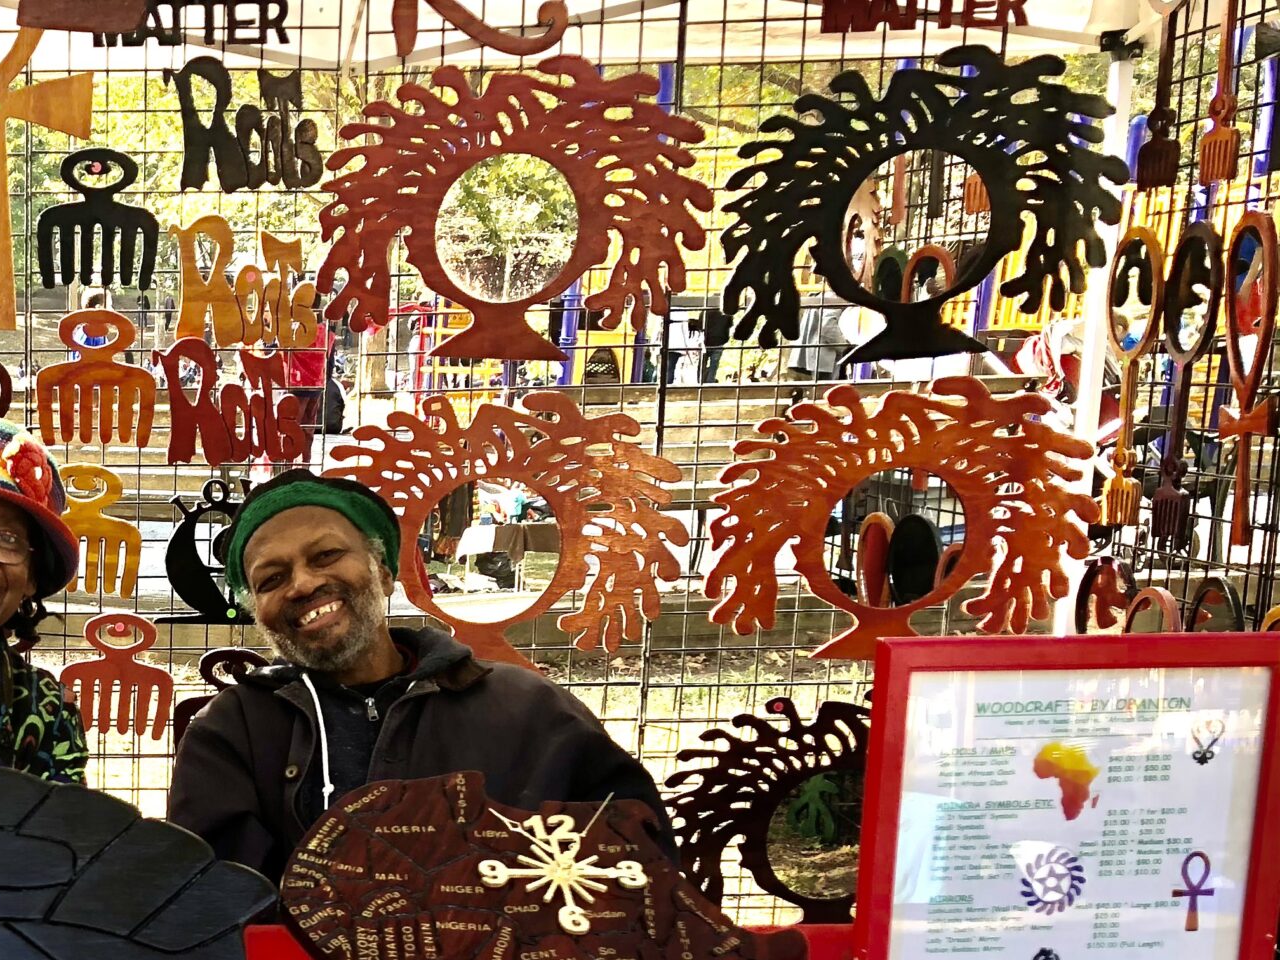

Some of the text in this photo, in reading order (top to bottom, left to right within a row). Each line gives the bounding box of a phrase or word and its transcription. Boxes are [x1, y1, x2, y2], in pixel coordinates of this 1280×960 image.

[93, 0, 290, 47] ATTER
[343, 785, 388, 814] Morocco
[985, 800, 1031, 809] SYMBOLS
[374, 825, 436, 834] ALGERIA
[523, 814, 576, 842] 12
[375, 873, 409, 881] MALI
[478, 859, 509, 888] 9
[616, 860, 648, 889] 3
[440, 885, 484, 894] NIGER
[379, 898, 407, 915] Faso
[504, 905, 540, 914] CHAD
[299, 907, 345, 929] GUINEA
[435, 921, 493, 931] NIGERIA
[558, 905, 591, 935] 6
[402, 926, 416, 959] TOGO
